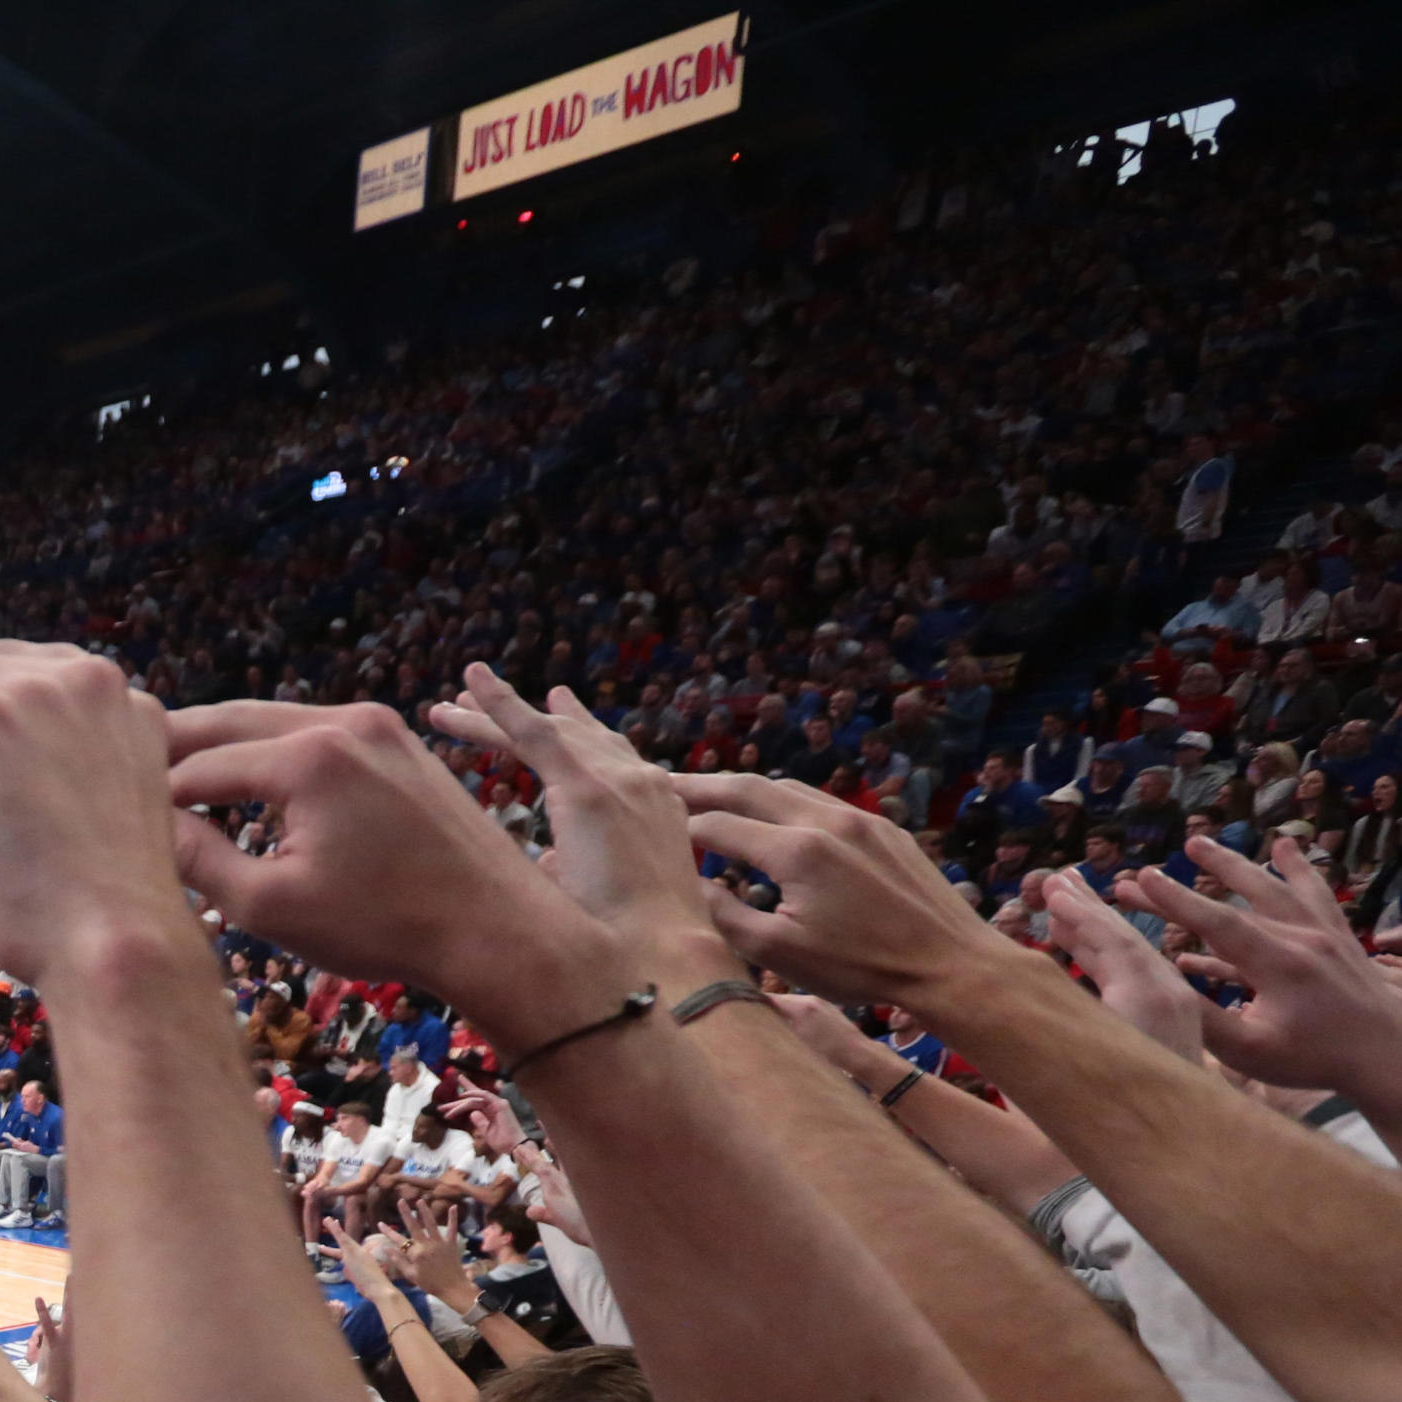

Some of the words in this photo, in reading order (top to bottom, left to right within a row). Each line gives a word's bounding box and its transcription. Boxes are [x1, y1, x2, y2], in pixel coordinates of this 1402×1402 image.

[464, 114, 519, 174] JUST
[524, 92, 587, 153] LOAD
[623, 41, 737, 121] WAGON
